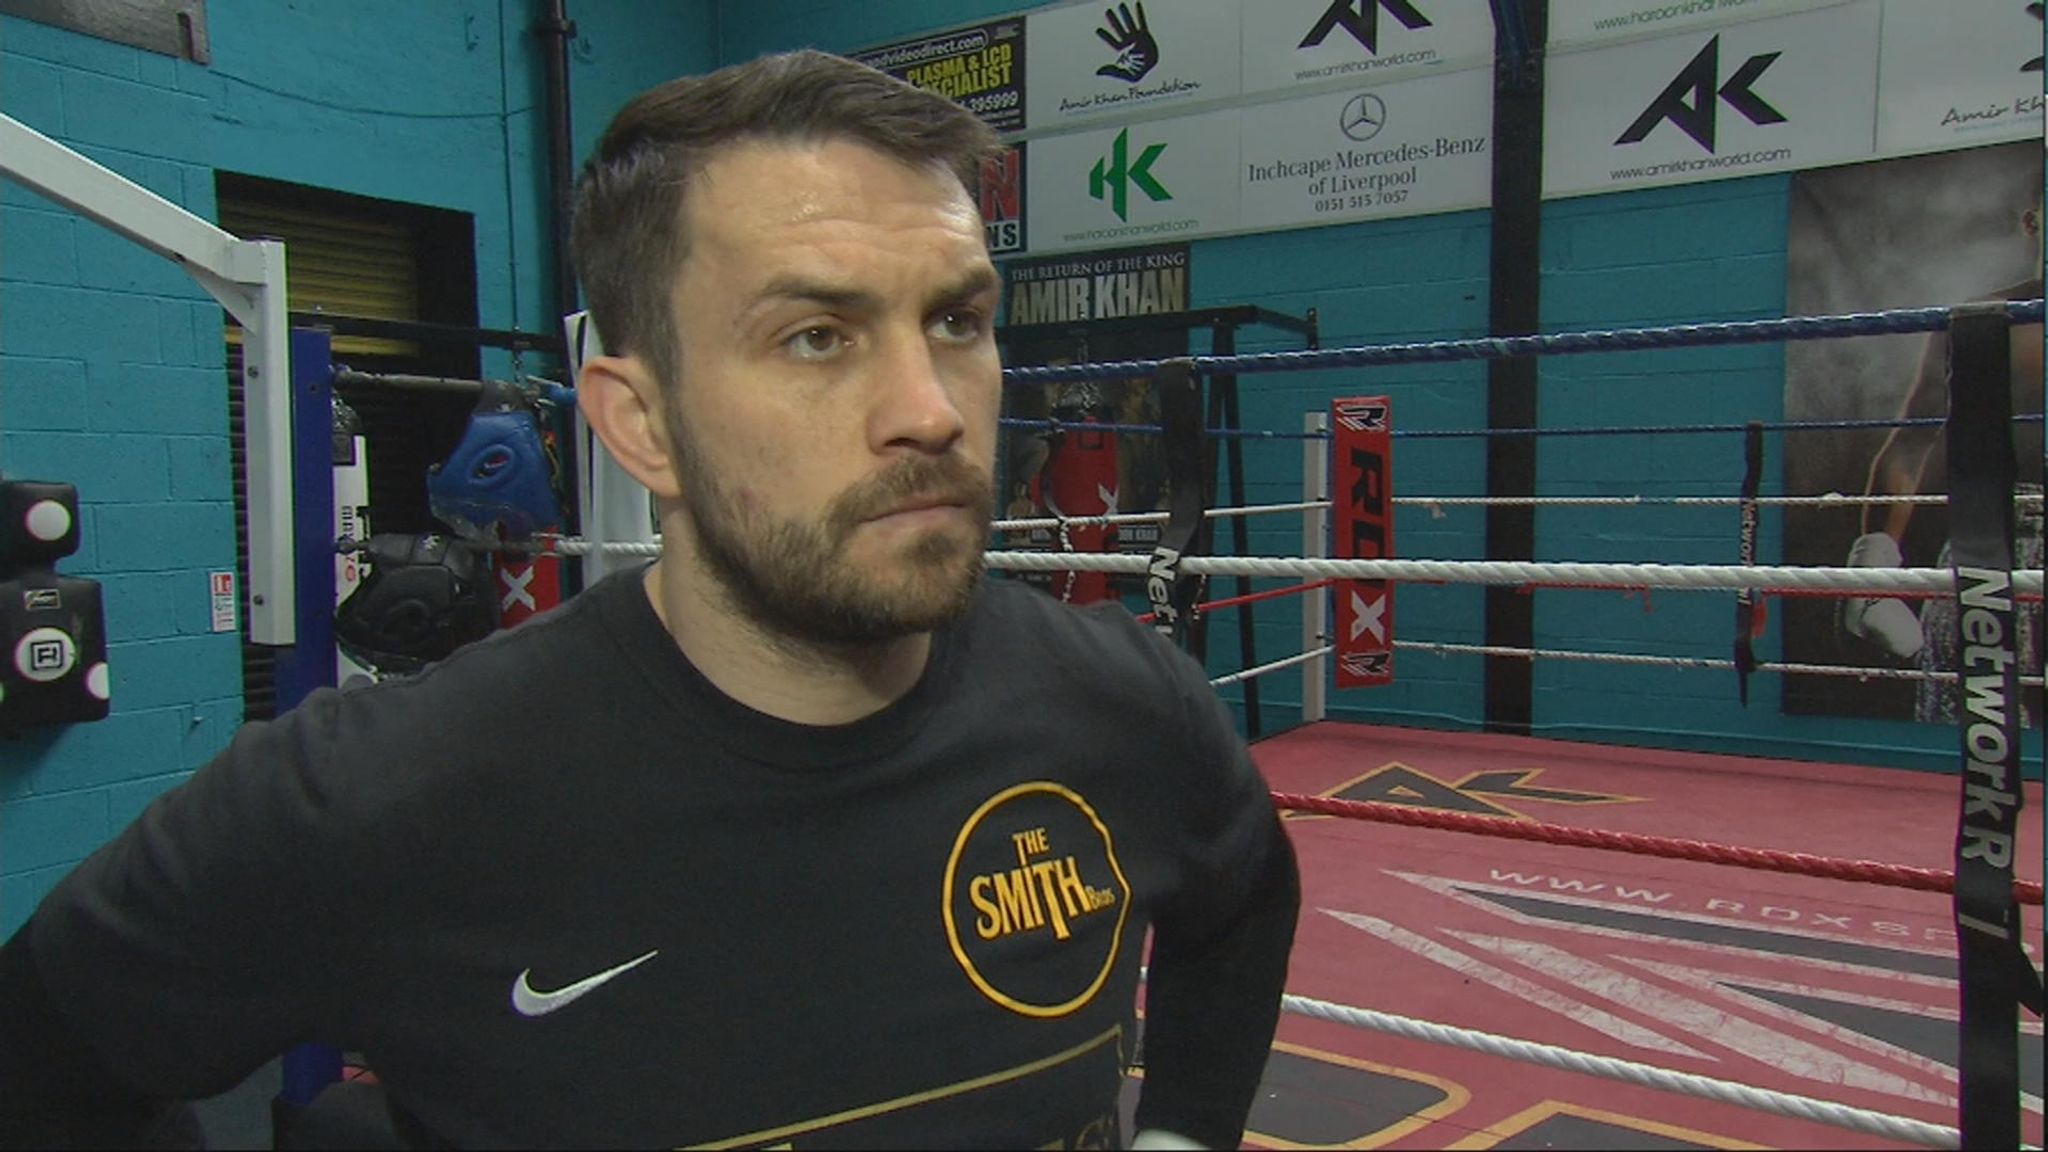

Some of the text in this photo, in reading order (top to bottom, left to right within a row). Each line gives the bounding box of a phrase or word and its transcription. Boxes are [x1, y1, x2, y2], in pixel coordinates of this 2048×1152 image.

[907, 43, 1013, 84] PLASMA & LCD
[1941, 106, 2009, 126] Amir
[1249, 136, 1487, 183] Inchcape Mercedes-Benz
[1610, 148, 1792, 180] www.amirkhanworld.com
[1308, 167, 1417, 196] of Liverpool
[1012, 252, 1186, 282] THE RETURN OF THE KING
[1009, 267, 1187, 326] AMIR KHAN
[1148, 546, 1180, 635] Net
[1012, 827, 1050, 866] THE
[969, 856, 1092, 939] SMITH
